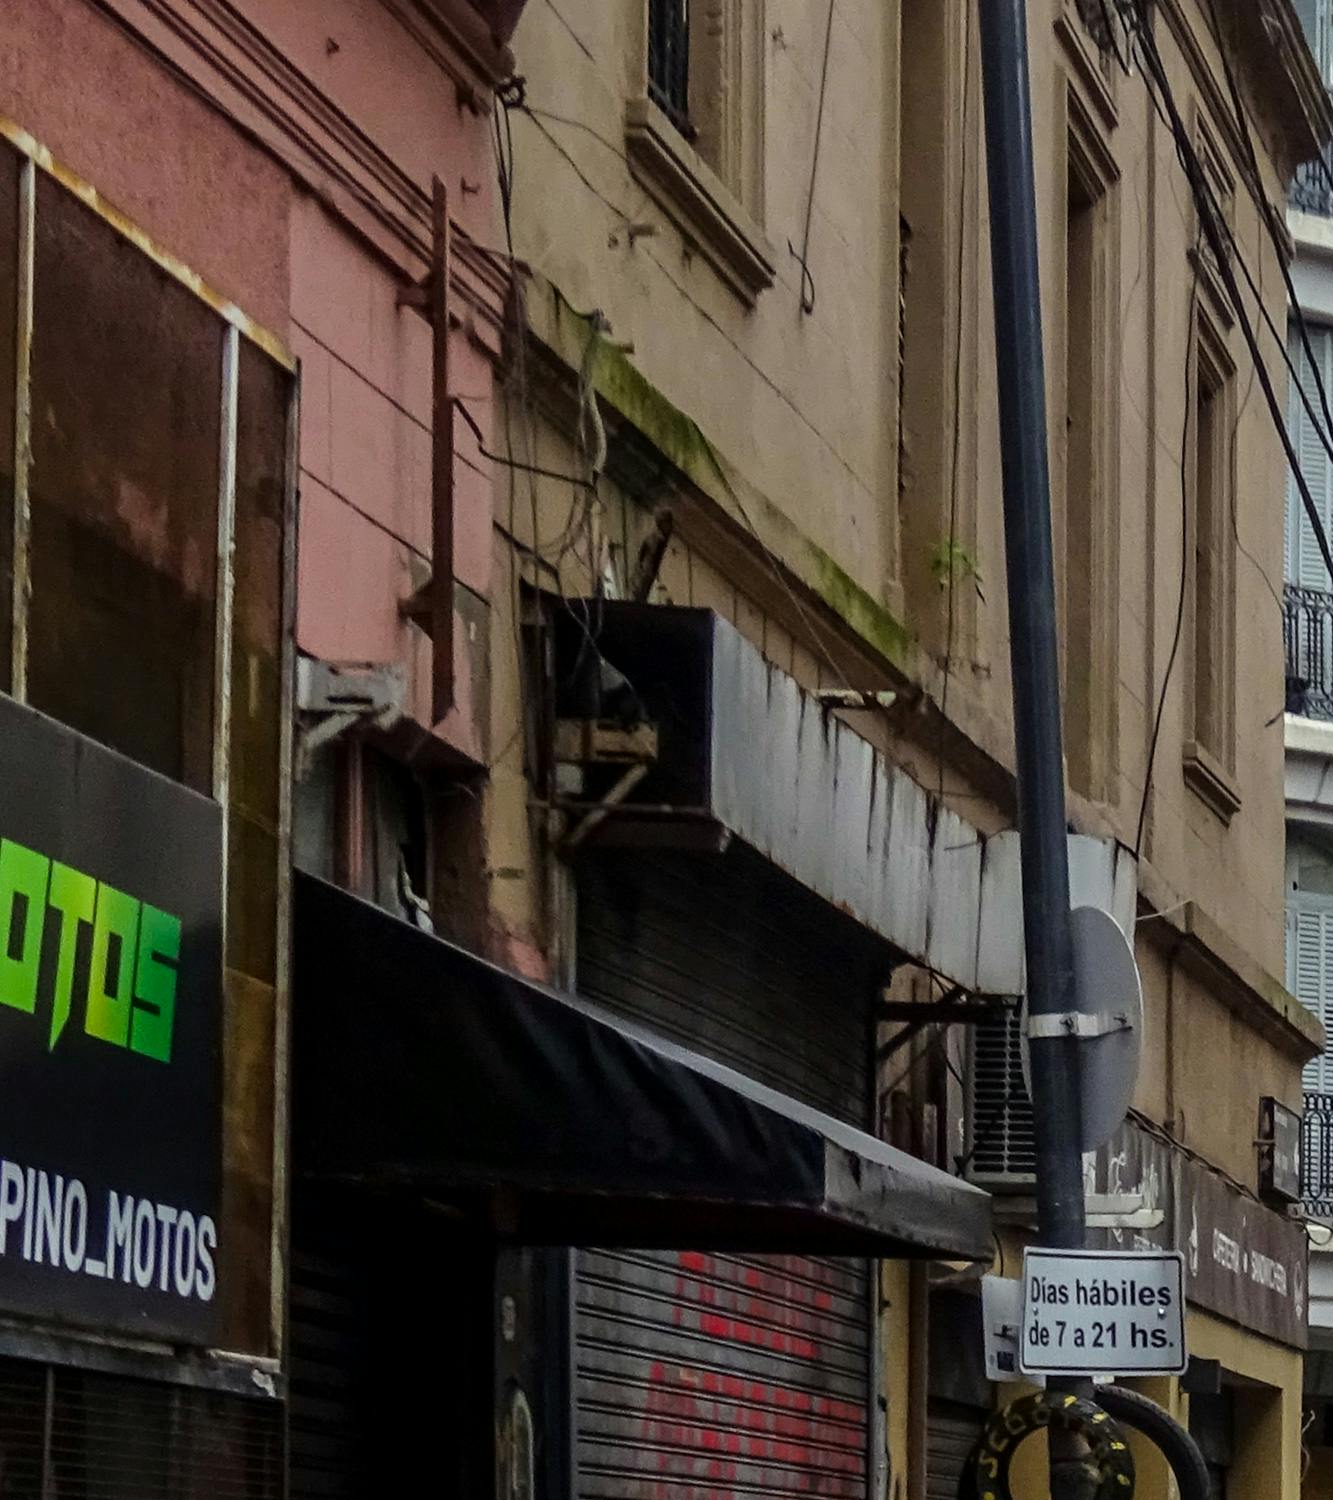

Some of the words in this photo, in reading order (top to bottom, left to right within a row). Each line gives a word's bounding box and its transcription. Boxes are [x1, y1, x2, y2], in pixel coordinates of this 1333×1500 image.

[1031, 1277, 1068, 1304] Días
[1076, 1279, 1172, 1306] hábiles
[1030, 1320, 1049, 1346] de
[1056, 1321, 1066, 1347] 7
[1074, 1328, 1085, 1347] a
[1092, 1322, 1117, 1348] 21
[1131, 1323, 1174, 1348] hs.
